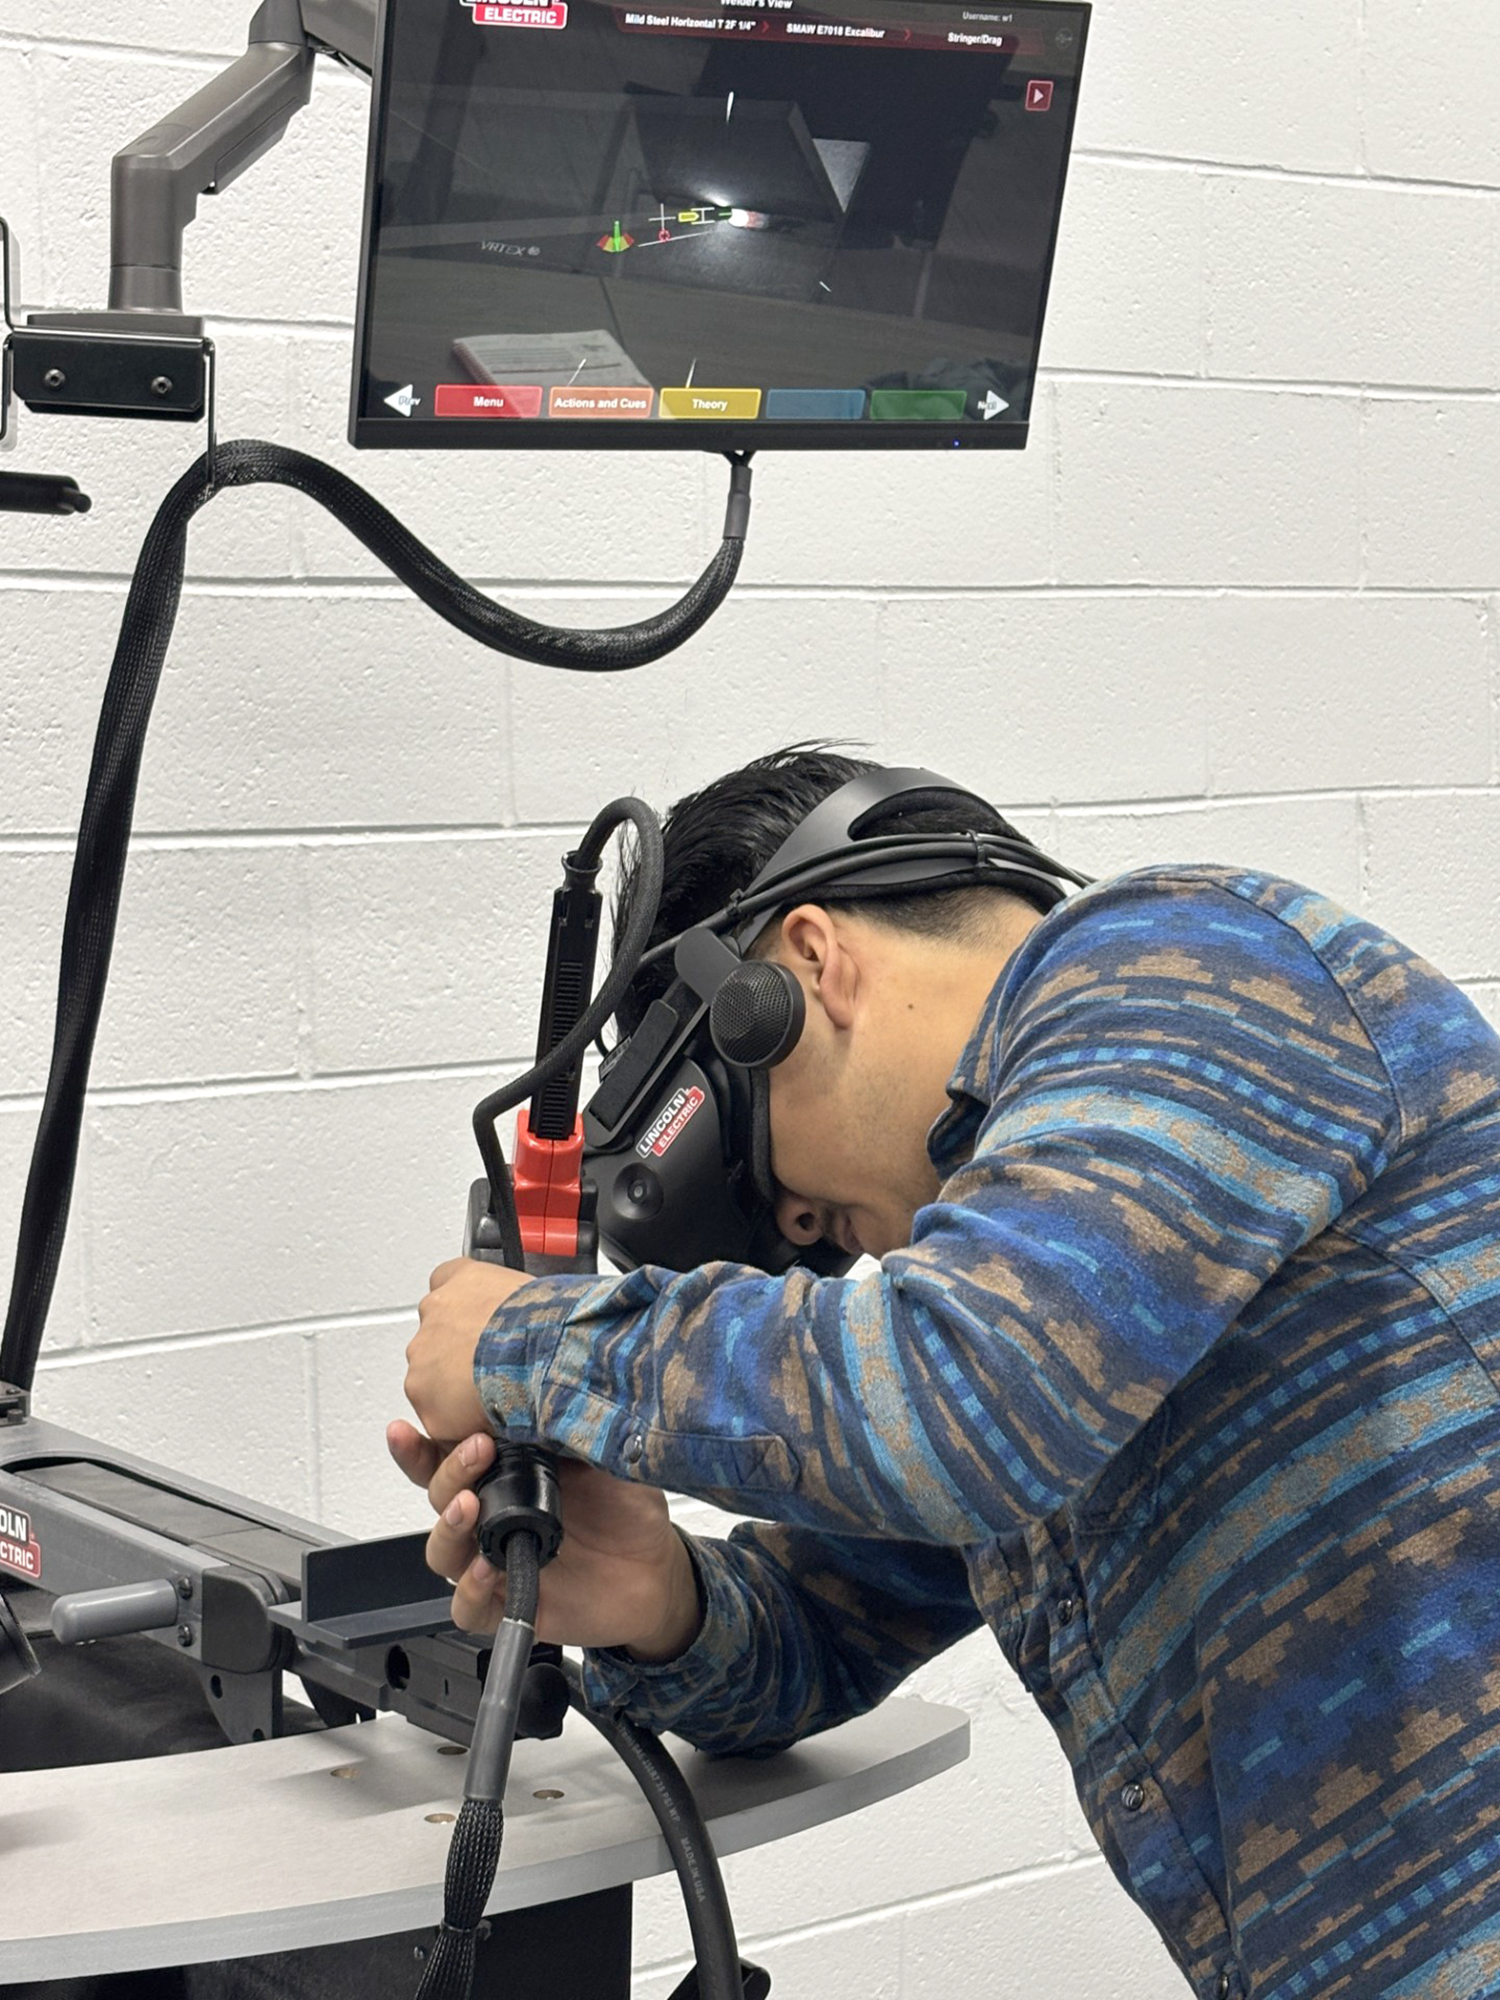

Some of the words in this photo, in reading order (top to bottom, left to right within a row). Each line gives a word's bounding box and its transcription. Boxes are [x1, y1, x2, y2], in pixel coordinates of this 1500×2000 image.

[484, 7, 557, 24] ELECTRIC
[625, 13, 645, 25] Mild
[646, 15, 669, 26] Steel
[671, 16, 716, 29] Horizontal
[718, 19, 724, 29] T
[724, 20, 737, 30] 2F
[962, 11, 1000, 22] Username:
[786, 22, 816, 35] SMAW
[817, 24, 843, 36] E7018
[844, 26, 885, 38] Excalibur
[948, 32, 1003, 47] Stringer/Drag
[473, 396, 504, 408] Menu
[554, 397, 595, 408] Actions
[597, 398, 617, 409] and
[619, 398, 647, 409] Cues
[692, 398, 728, 411] Theory
[640, 1093, 686, 1153] LINCOLN
[658, 1096, 699, 1148] ELECTRIC
[0, 1540, 34, 1570] CTRIC
